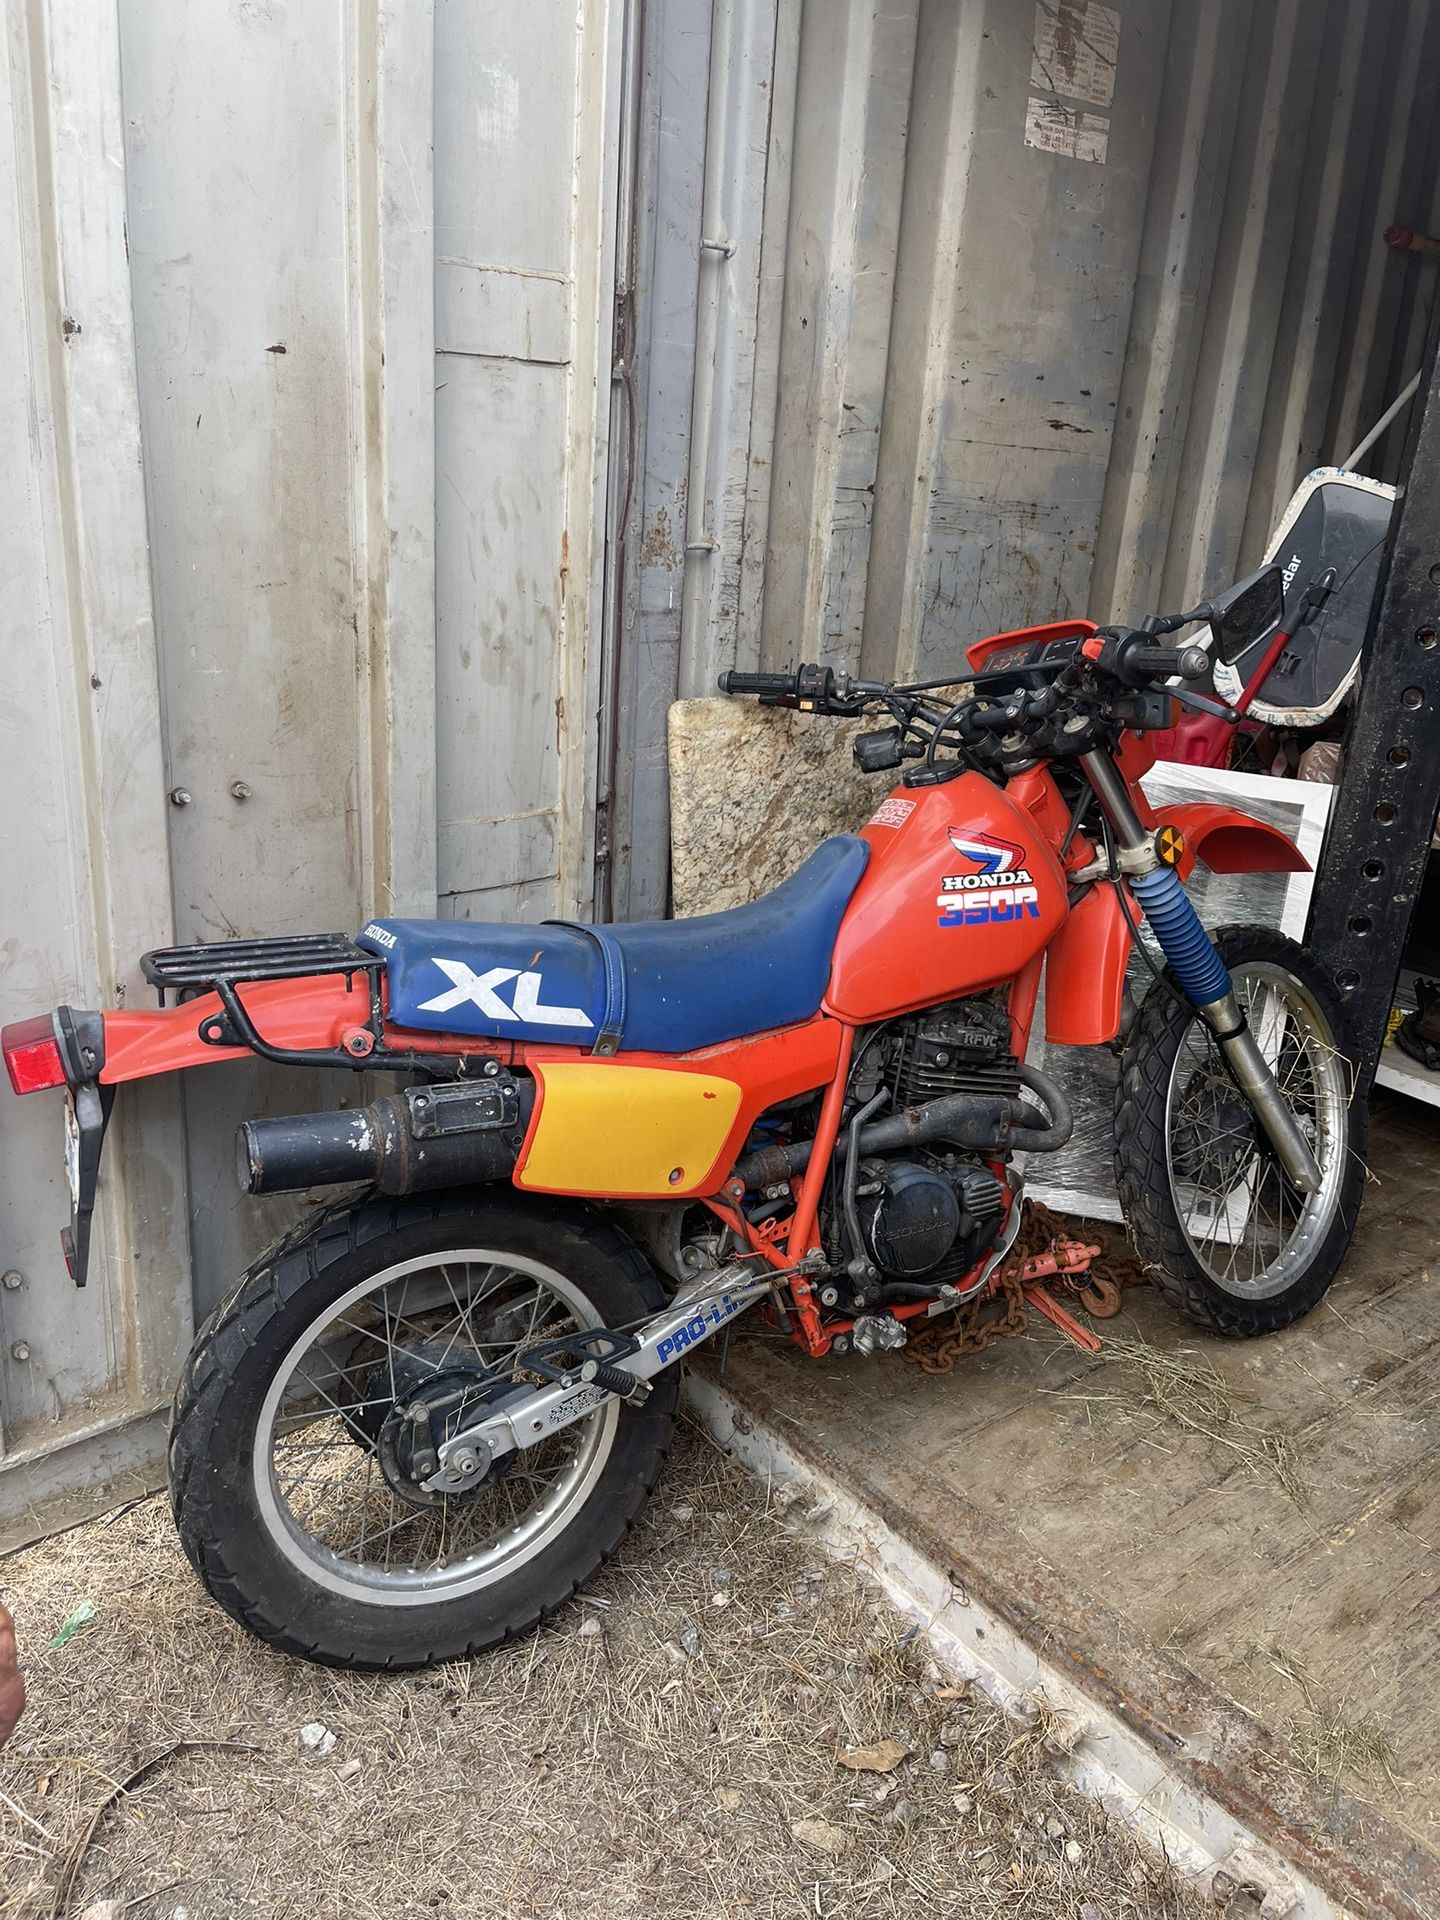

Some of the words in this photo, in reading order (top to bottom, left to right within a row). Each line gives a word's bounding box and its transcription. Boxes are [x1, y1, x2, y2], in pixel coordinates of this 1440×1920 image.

[1282, 554, 1301, 597] edar
[942, 870, 1033, 891] HONDA
[937, 887, 1040, 927] 350R
[364, 924, 398, 949] HONDA
[417, 958, 594, 1027] XL
[964, 1032, 998, 1047] RFVC
